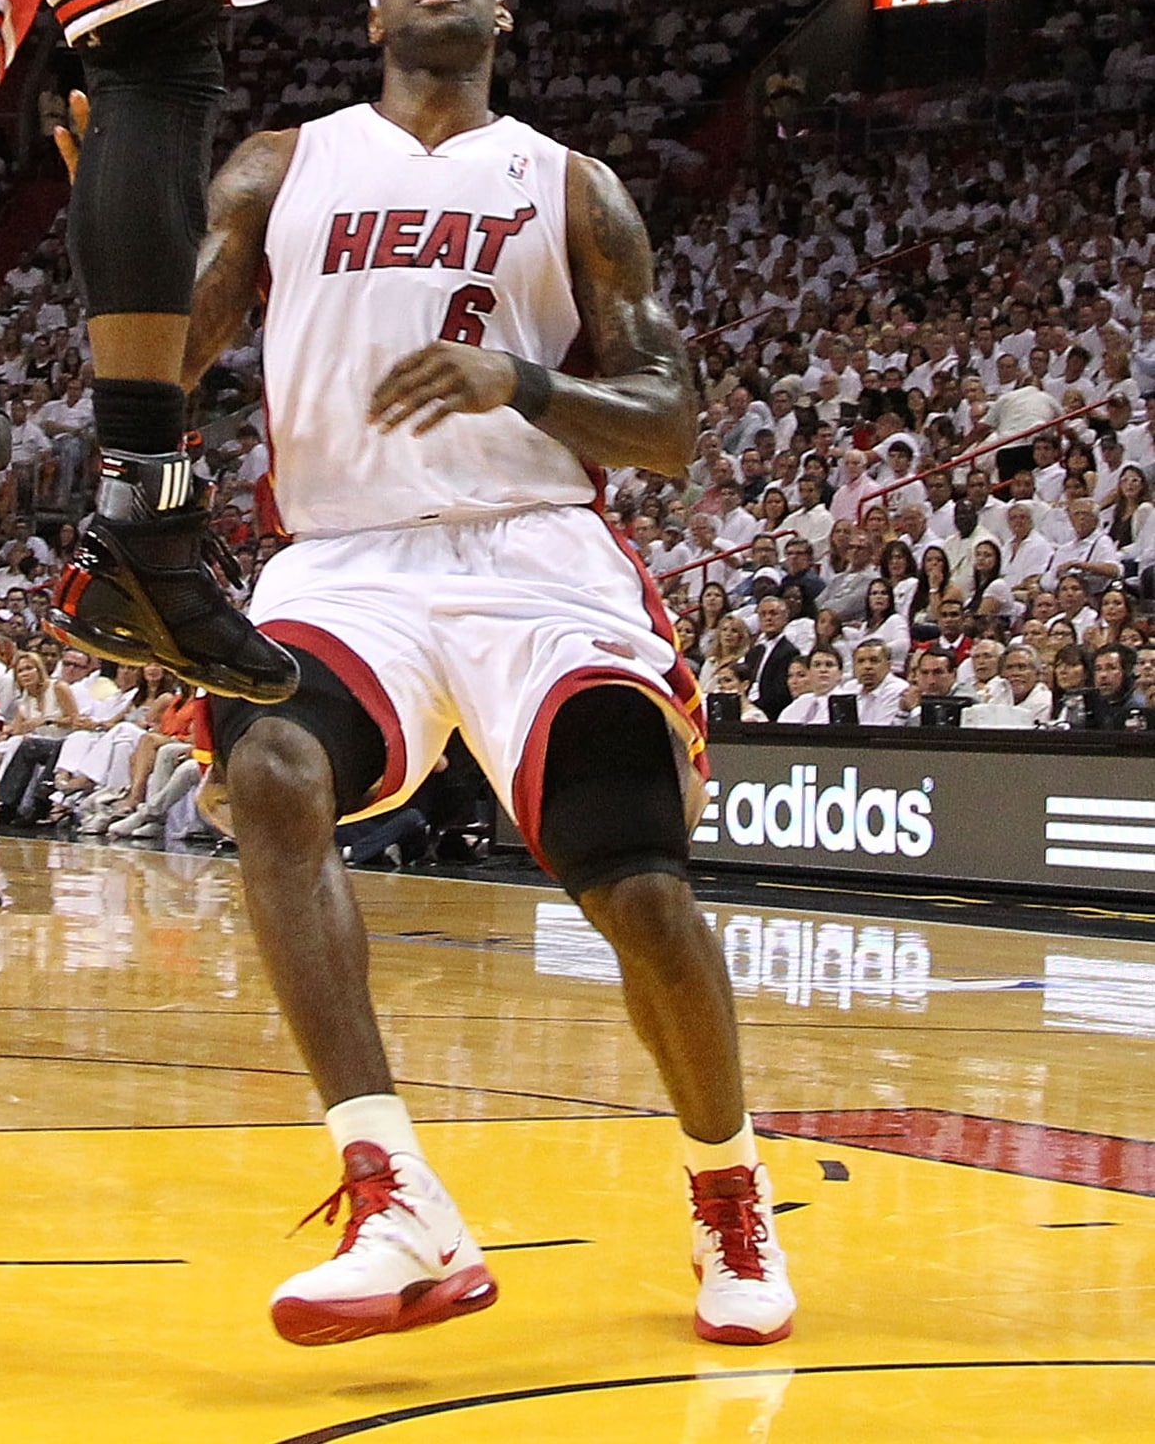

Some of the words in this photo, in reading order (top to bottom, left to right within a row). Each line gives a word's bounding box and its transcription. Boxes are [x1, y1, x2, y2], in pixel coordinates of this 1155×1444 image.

[322, 204, 536, 275] HEAT
[439, 283, 497, 346] 6
[725, 764, 934, 856] adidas
